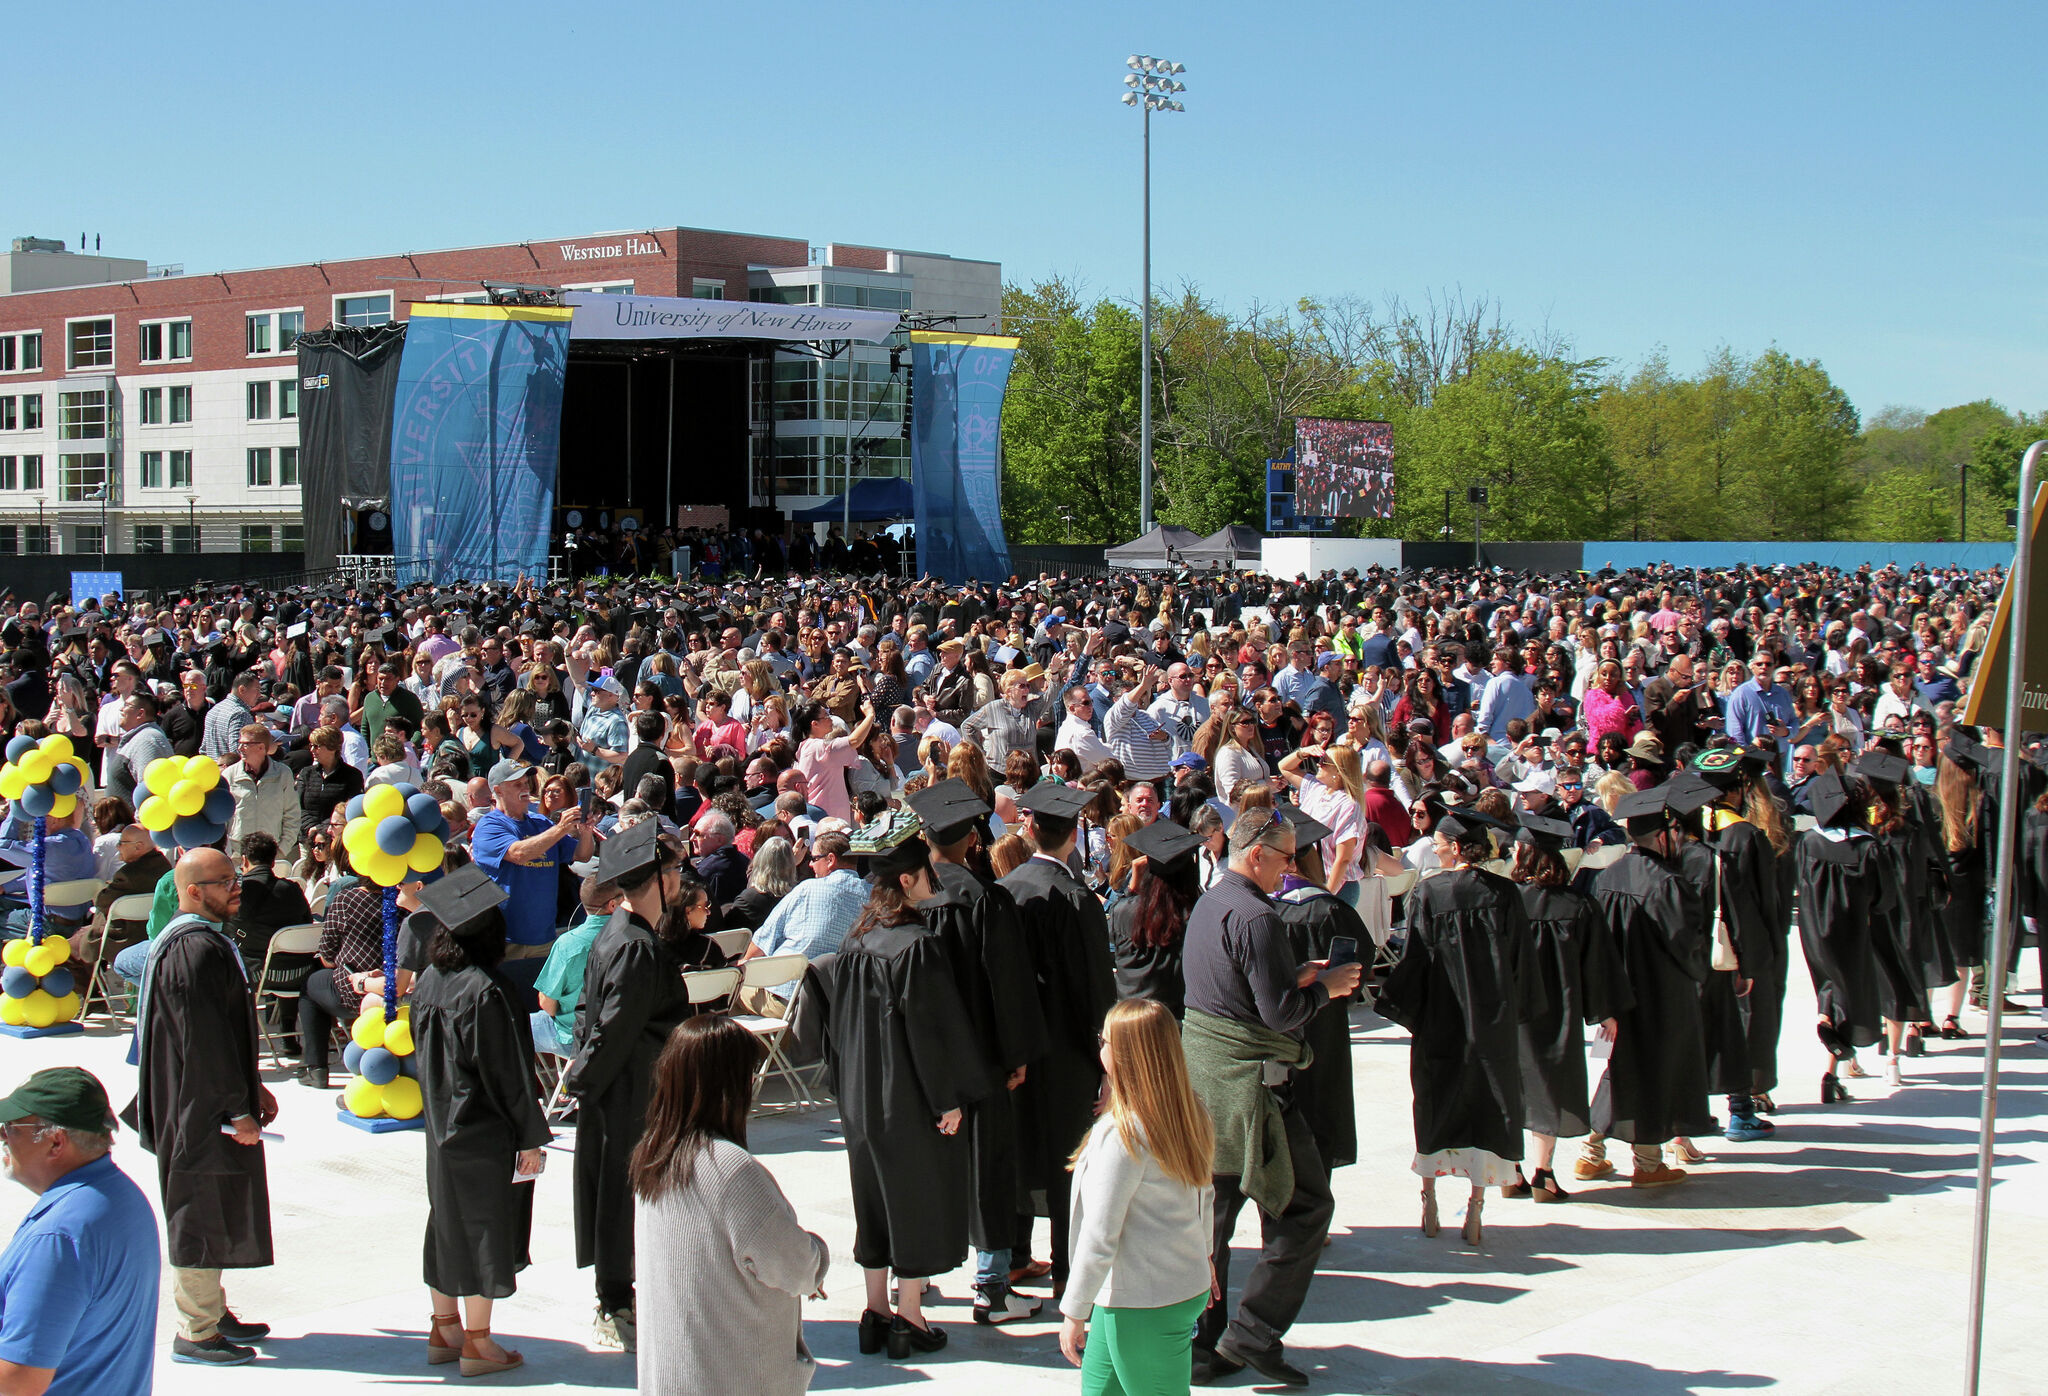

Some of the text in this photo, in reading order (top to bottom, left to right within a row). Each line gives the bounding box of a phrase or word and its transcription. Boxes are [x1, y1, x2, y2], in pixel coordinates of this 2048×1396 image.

[615, 301, 852, 332] University of New Haven
[1271, 462, 1291, 470] KATHY
[2021, 682, 2048, 710] nive
